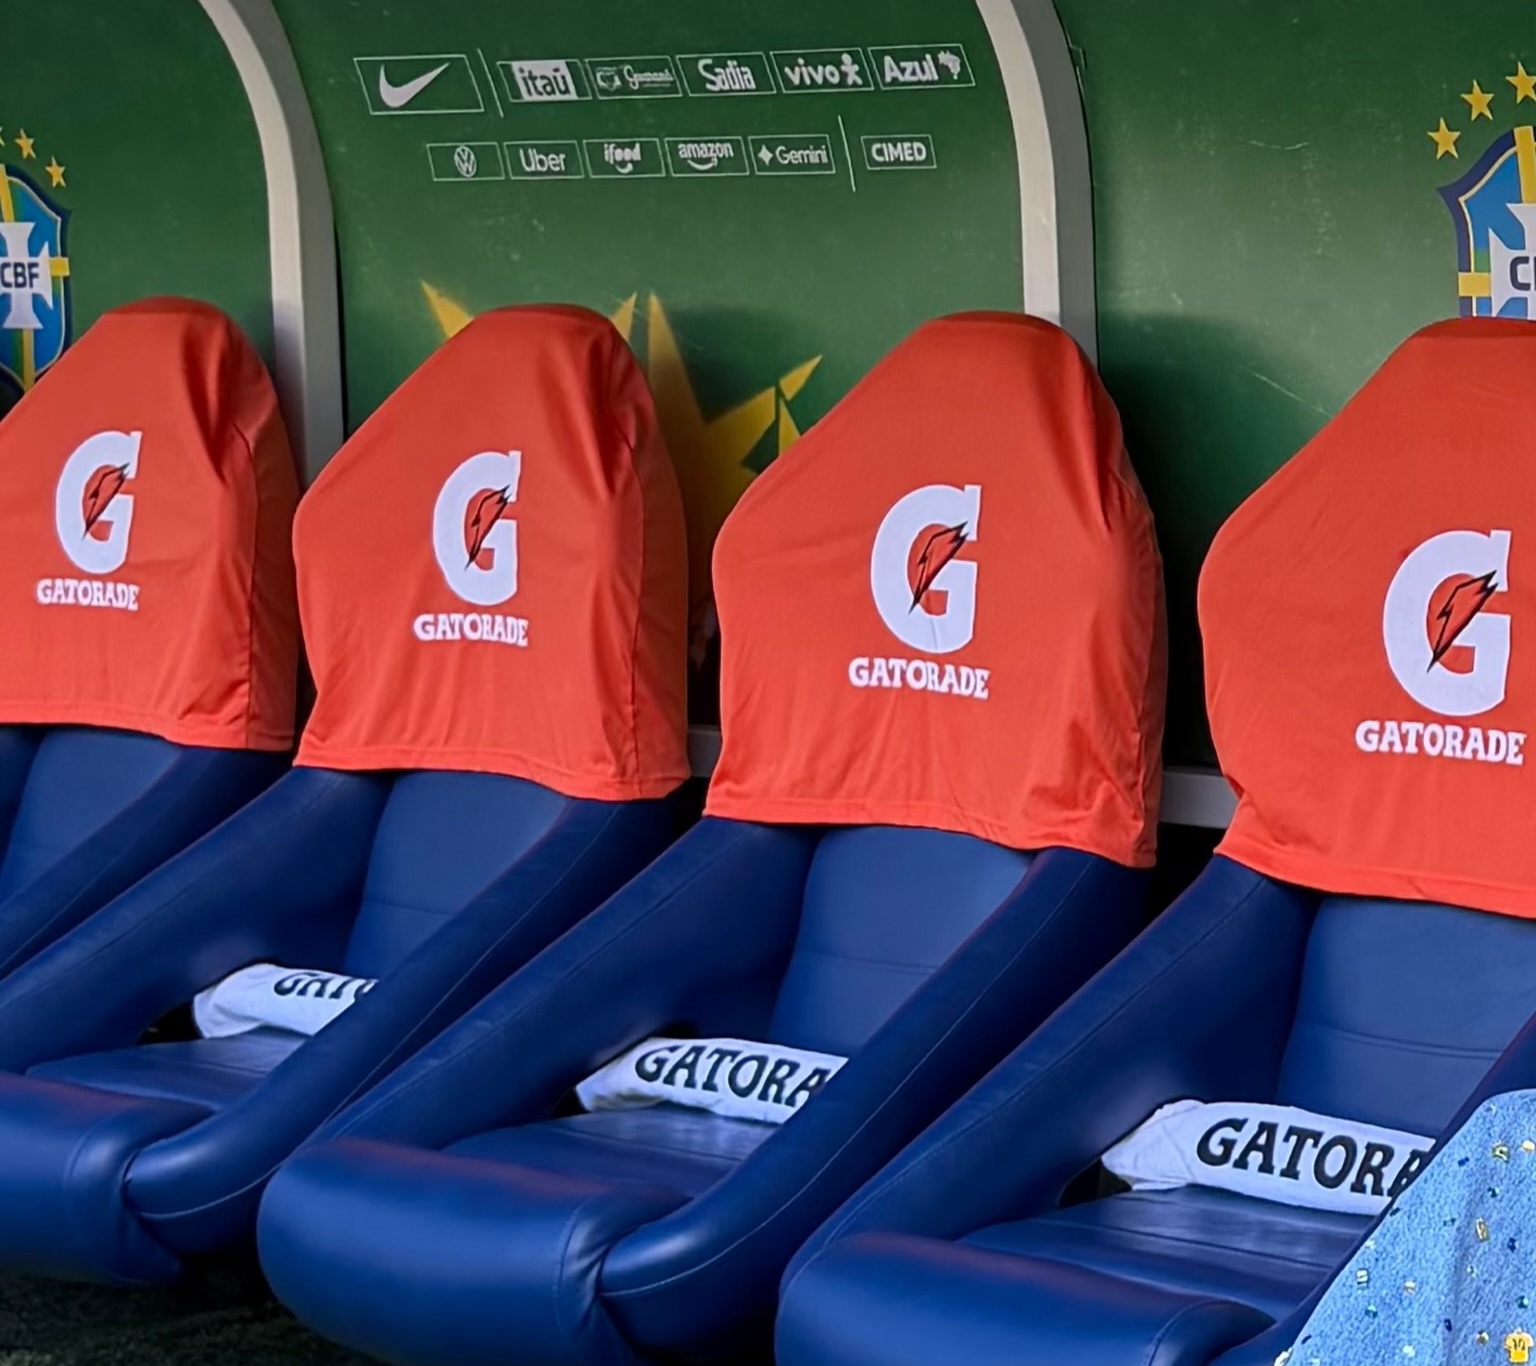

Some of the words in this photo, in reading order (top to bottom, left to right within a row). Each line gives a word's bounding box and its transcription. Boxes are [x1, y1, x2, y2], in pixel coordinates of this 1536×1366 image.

[518, 65, 571, 97] itaú
[698, 58, 757, 91] Sadia
[785, 57, 840, 86] vivo
[883, 54, 940, 84] Azul
[519, 148, 566, 173] Uber
[678, 142, 735, 160] amazon
[775, 144, 829, 165] Gemini
[871, 142, 927, 162] CIMED
[0, 262, 40, 289] CBF
[36, 578, 141, 611] GATORADE
[413, 613, 529, 647] GATORADE
[848, 656, 991, 700] GATORADE
[1355, 720, 1527, 766] GATORADE
